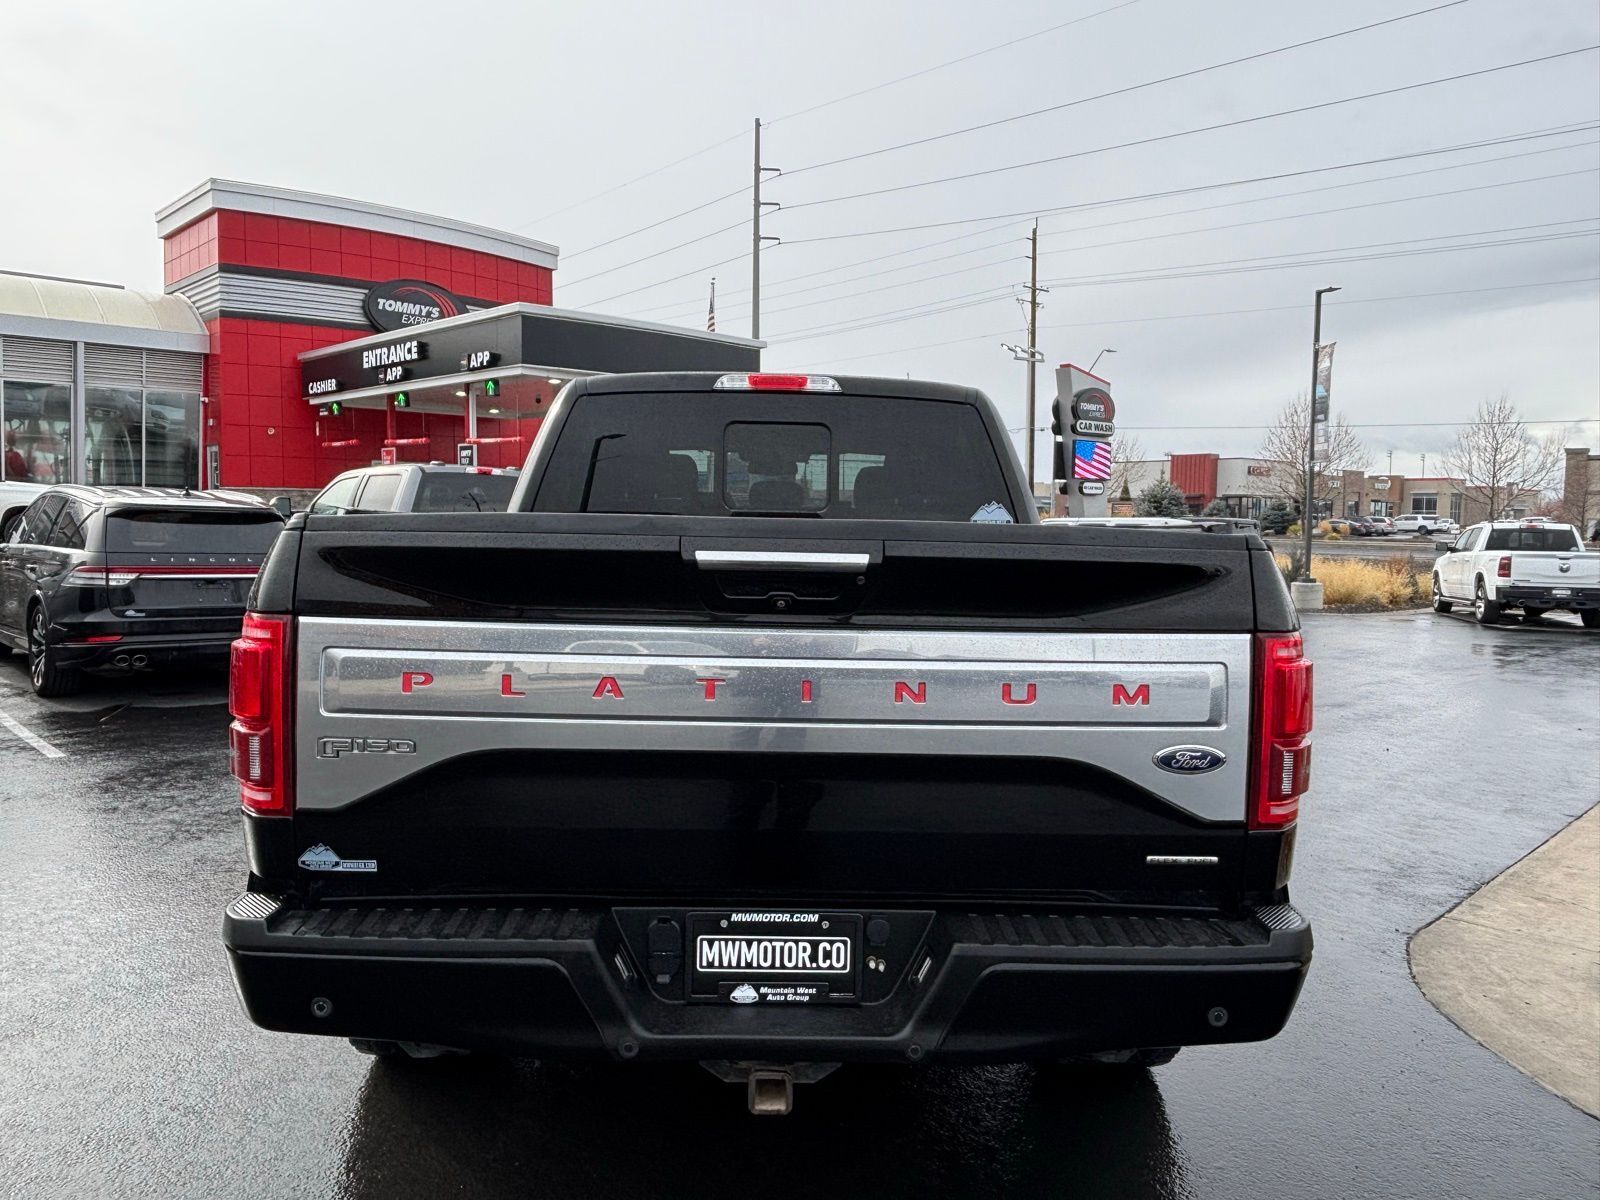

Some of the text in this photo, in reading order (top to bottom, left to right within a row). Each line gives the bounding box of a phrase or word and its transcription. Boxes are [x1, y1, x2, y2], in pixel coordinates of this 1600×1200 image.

[378, 298, 440, 318] TOMMY'S
[401, 314, 438, 324] EXPRE
[363, 341, 418, 368] ENTRANCE
[470, 351, 490, 367] APP
[386, 367, 402, 381] APP
[309, 379, 336, 394] CASHIER
[1080, 402, 1105, 411] TOMMY'S
[1079, 422, 1113, 432] CAR WASH
[401, 671, 1150, 706] PLATINUM
[1171, 751, 1211, 768] Ford
[731, 912, 819, 922] MWMOTOR.COM
[702, 940, 845, 968] MWMOTOR.CO
[760, 986, 794, 994] Mountain
[786, 994, 809, 1002] Group
